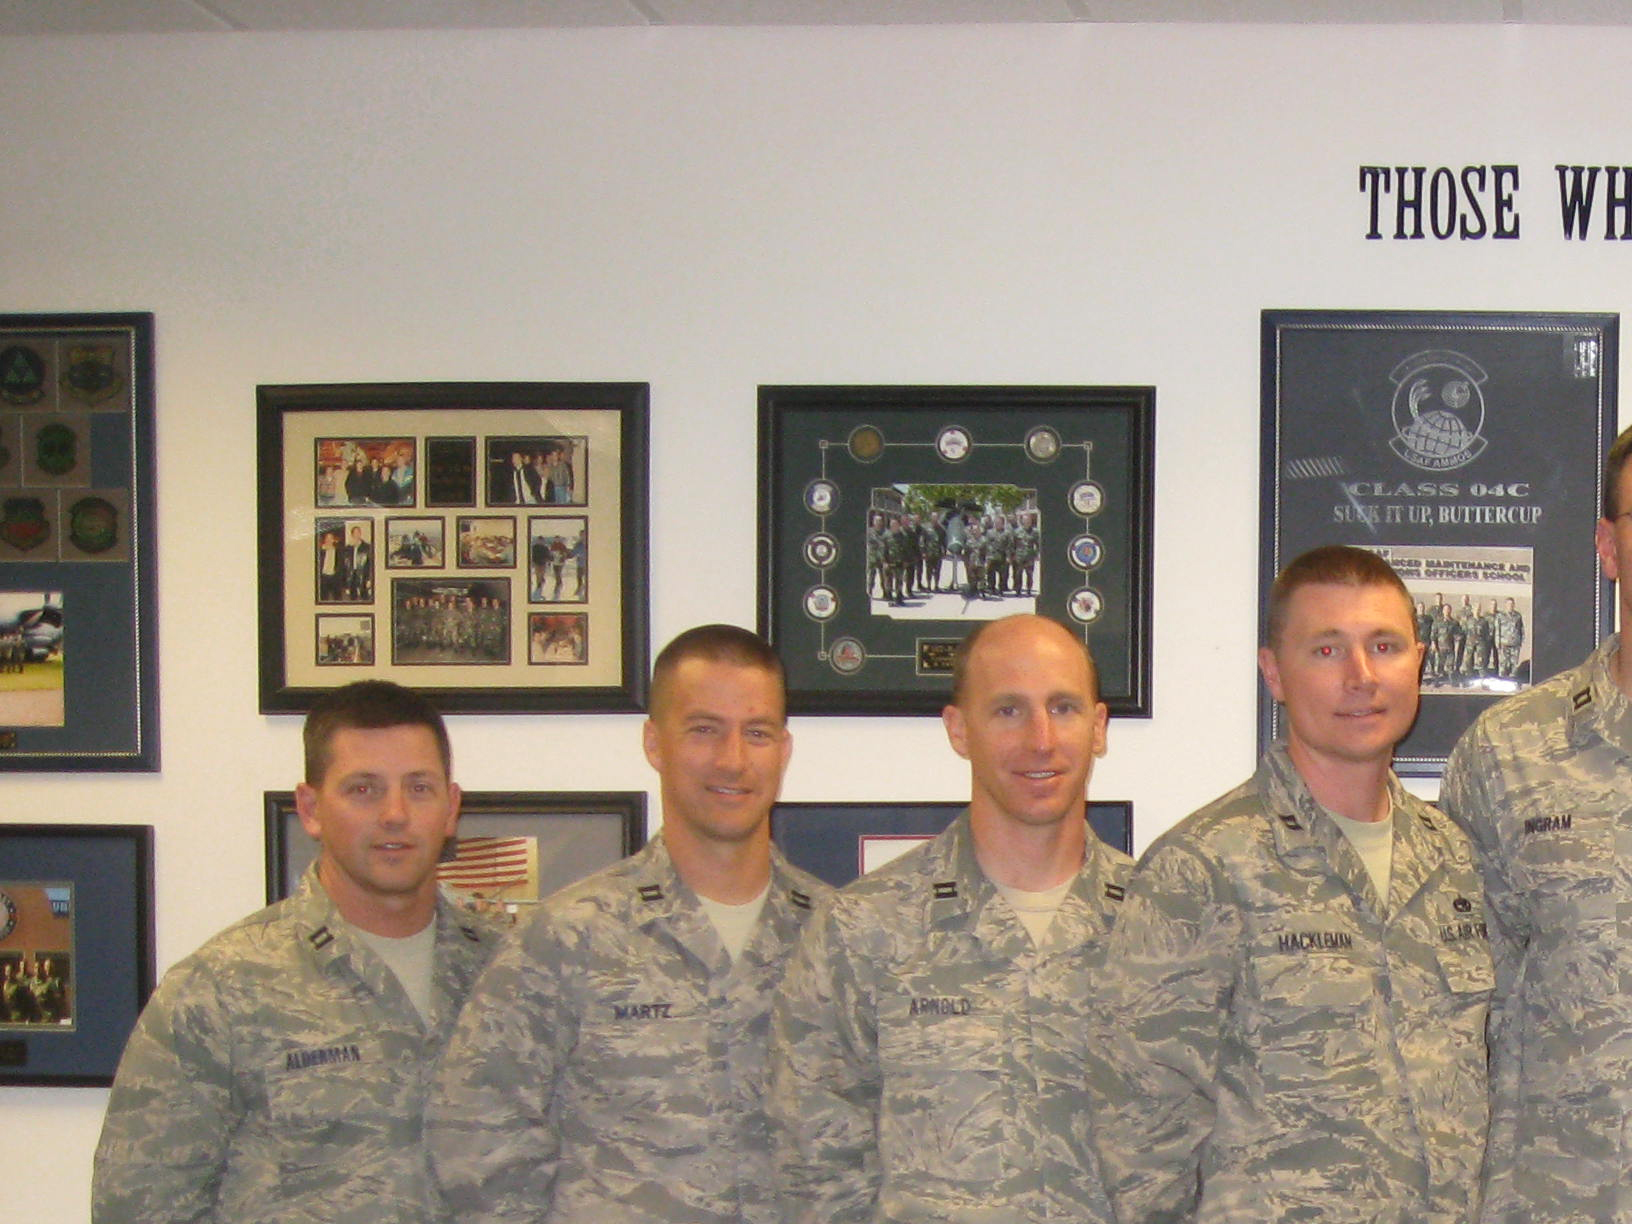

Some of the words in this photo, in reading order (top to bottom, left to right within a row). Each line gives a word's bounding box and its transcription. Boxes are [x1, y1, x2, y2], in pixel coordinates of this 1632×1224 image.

[1359, 165, 1520, 240] THOSE
[1348, 482, 1459, 497] CLASS
[1470, 483, 1530, 497] 04C
[1385, 505, 1403, 523] IT
[1408, 505, 1434, 527] UP,
[1438, 505, 1542, 524] BUTTERCUP
[1425, 569, 1479, 579] OFFICERS
[1482, 571, 1526, 581] SCHOOL
[1509, 563, 1531, 572] AND
